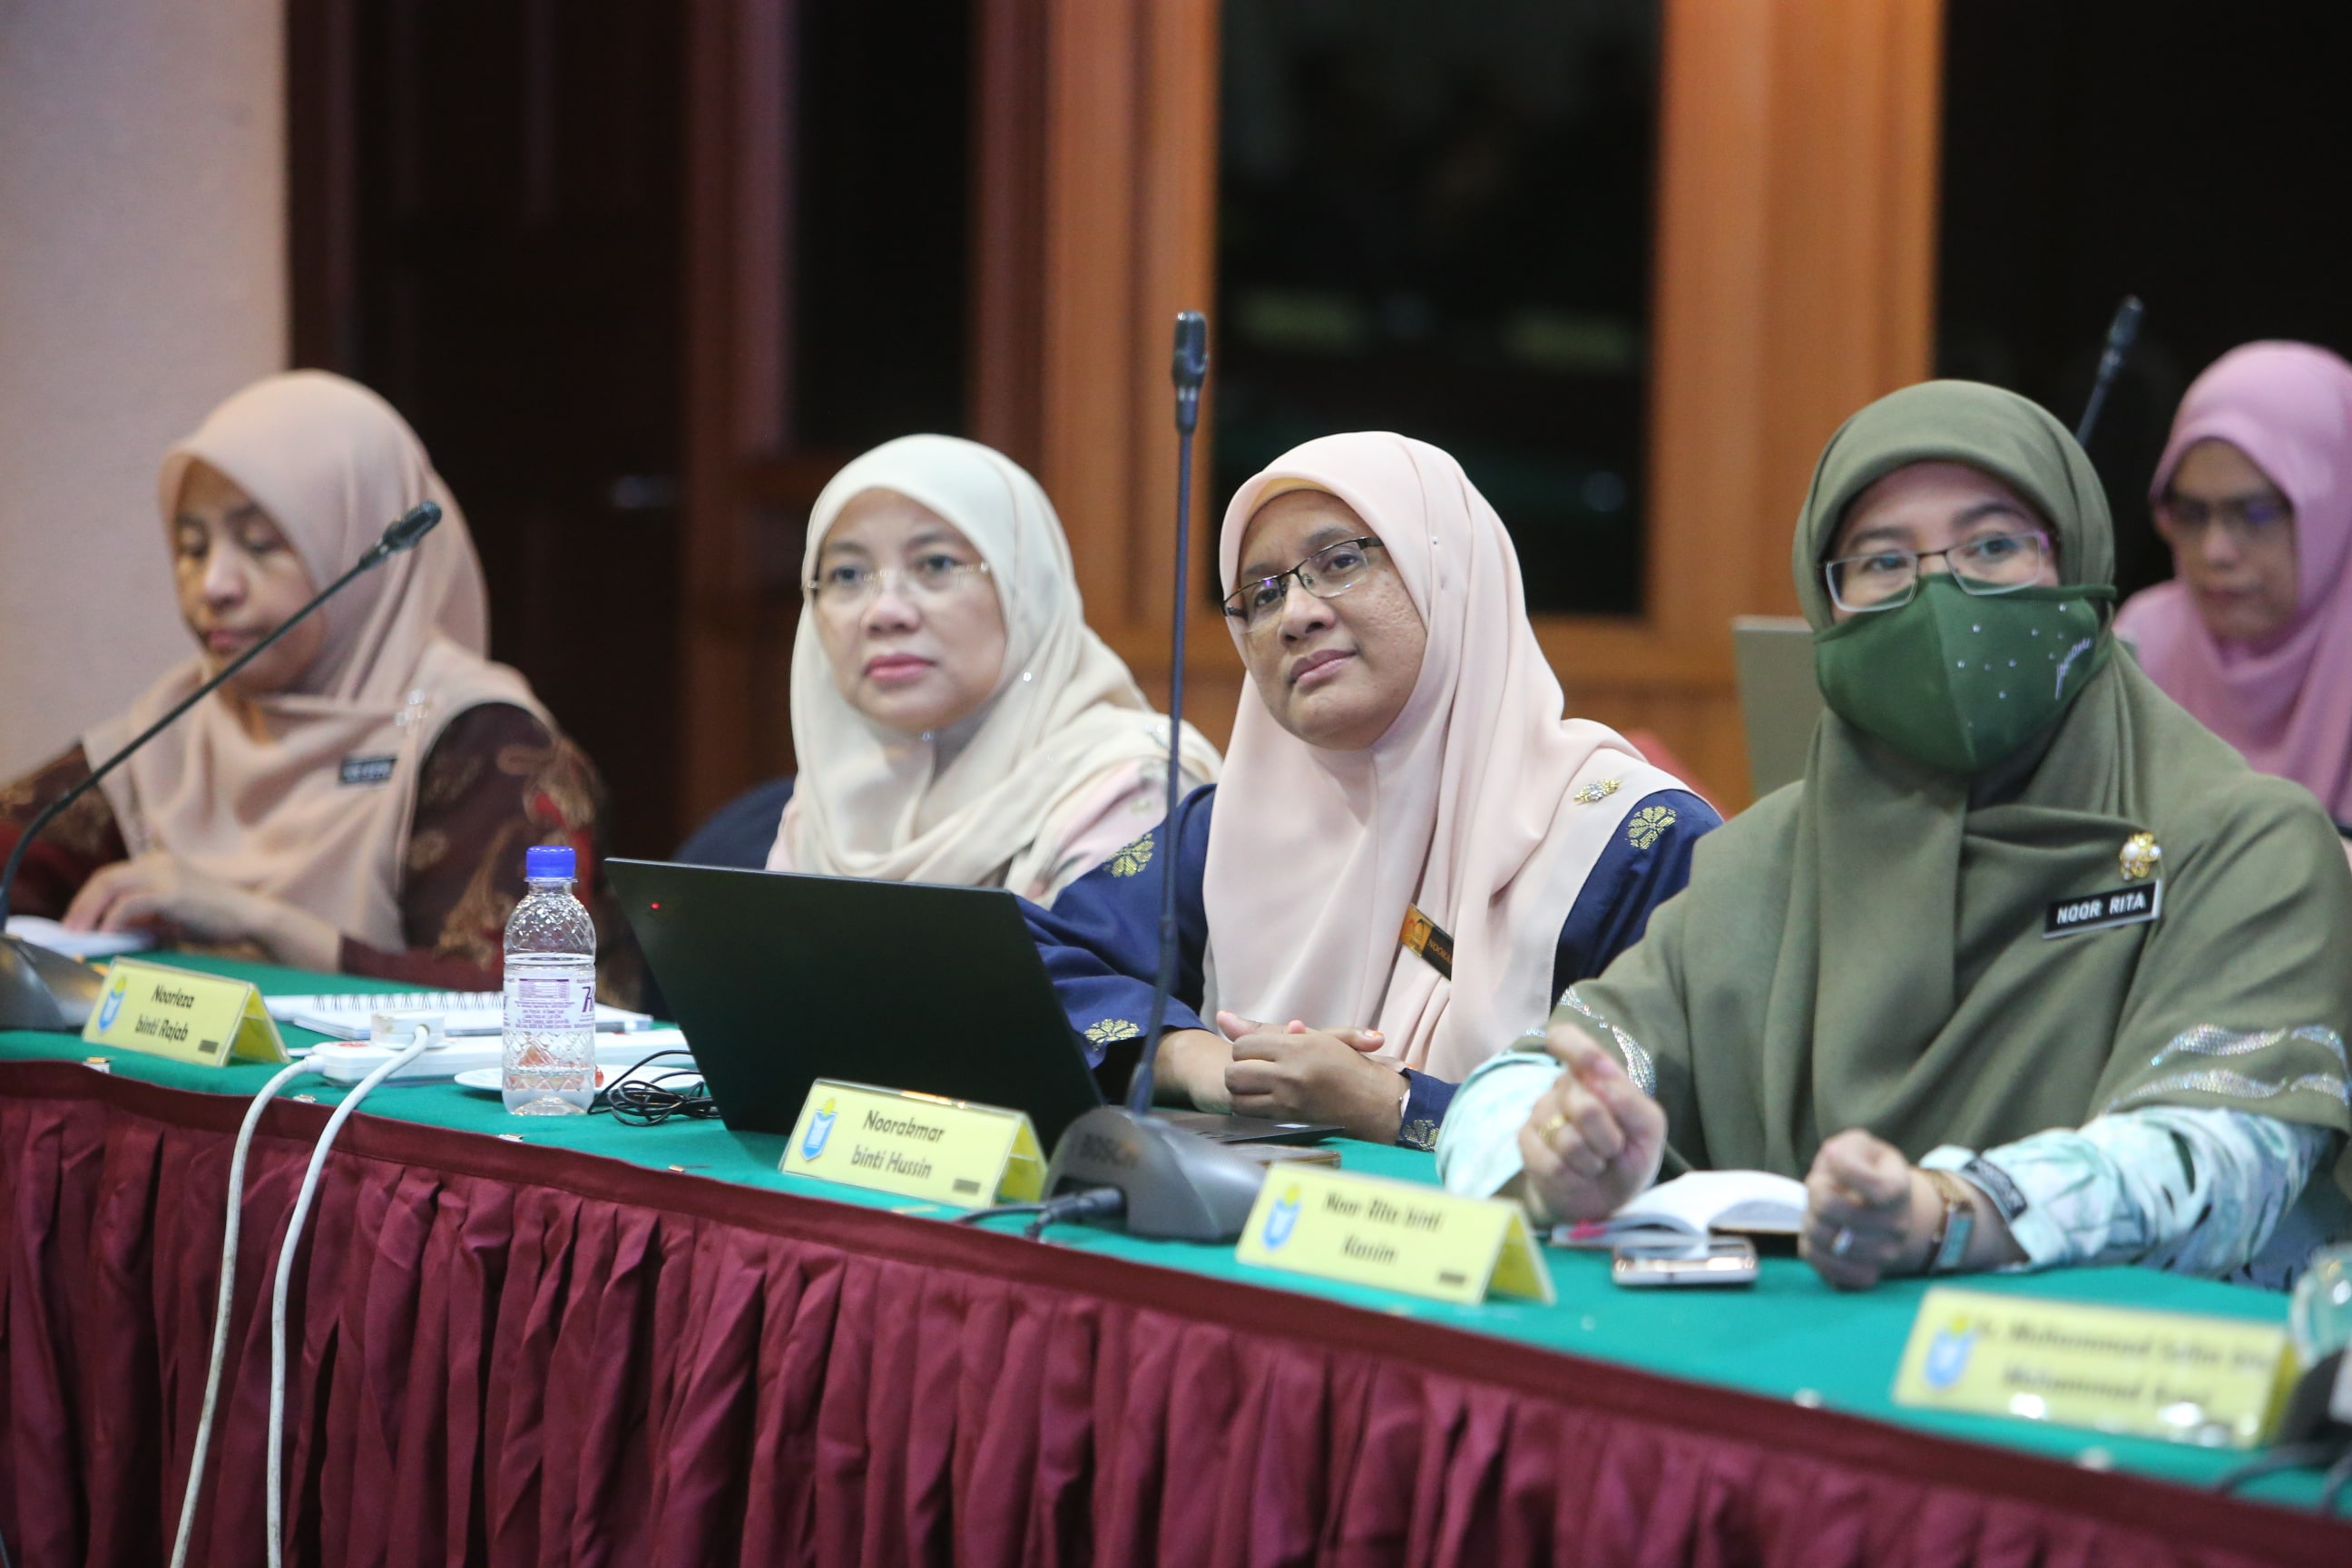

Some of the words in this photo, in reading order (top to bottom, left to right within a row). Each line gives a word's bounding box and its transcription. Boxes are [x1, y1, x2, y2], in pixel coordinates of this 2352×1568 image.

[2056, 899, 2103, 926] NOOR
[2109, 890, 2148, 916] RITA
[151, 985, 195, 1009] Noorleza
[134, 1014, 159, 1035] binti
[159, 1018, 190, 1043] Rajab
[862, 1109, 946, 1143] Noorakmar
[850, 1144, 886, 1169] binti
[885, 1152, 933, 1180] Hussin
